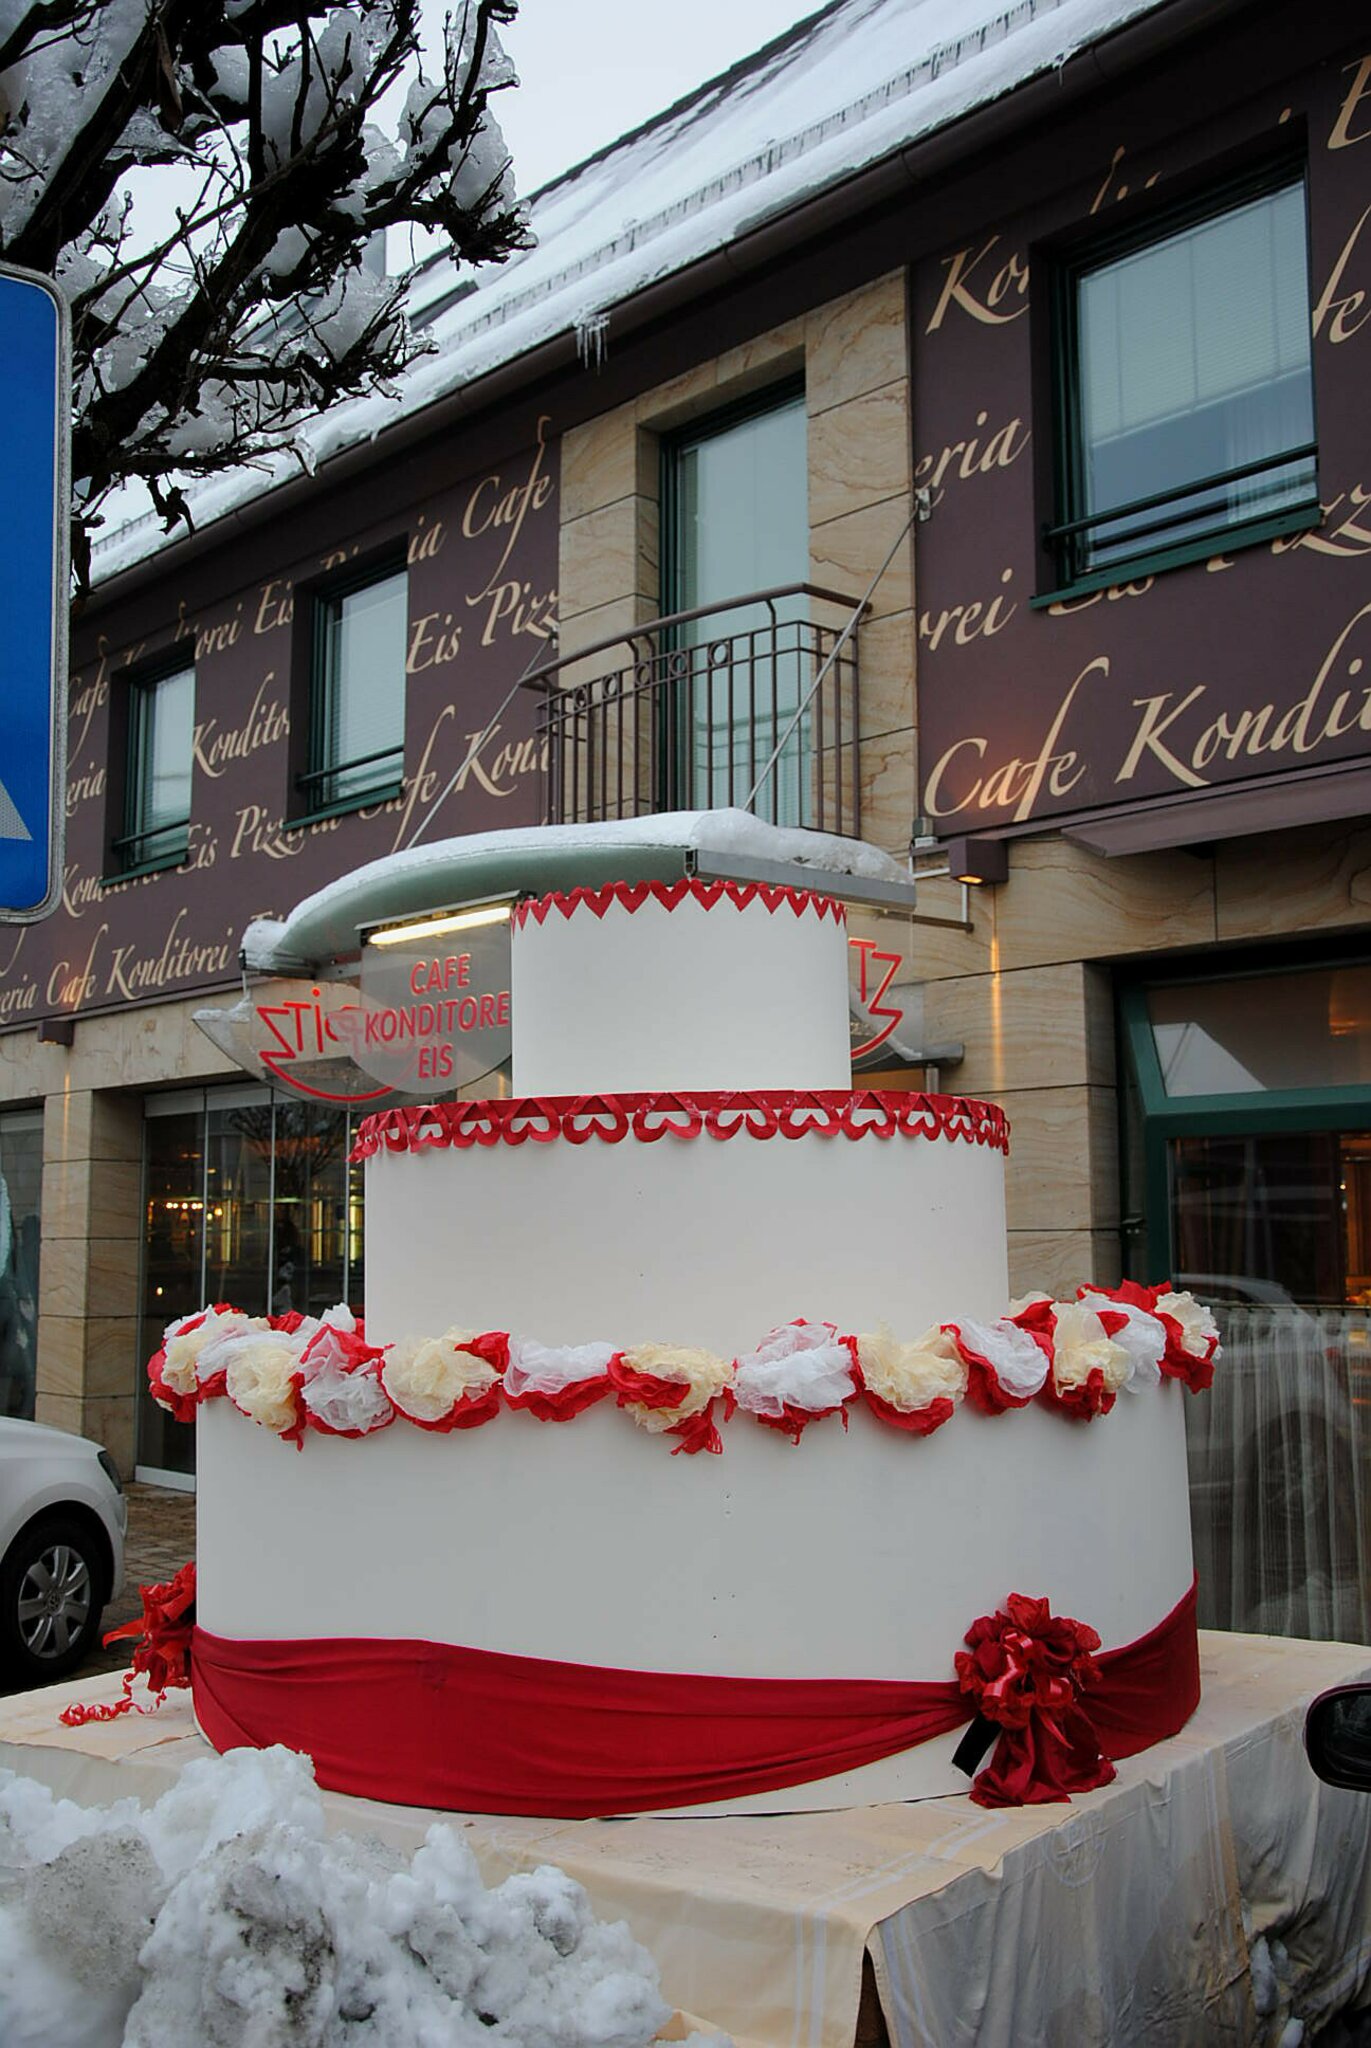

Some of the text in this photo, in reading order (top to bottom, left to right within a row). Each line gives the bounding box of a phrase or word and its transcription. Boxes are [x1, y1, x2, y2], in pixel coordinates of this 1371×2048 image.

[462, 416, 555, 606] Cafe
[405, 613, 462, 673] Eis
[924, 656, 1110, 822] Cafe
[47, 923, 109, 1011] Cafe
[105, 907, 233, 1000] Konditorei
[410, 953, 471, 996] CAFE
[365, 991, 511, 1046] KONDITORE
[418, 1043, 454, 1079] EIS
